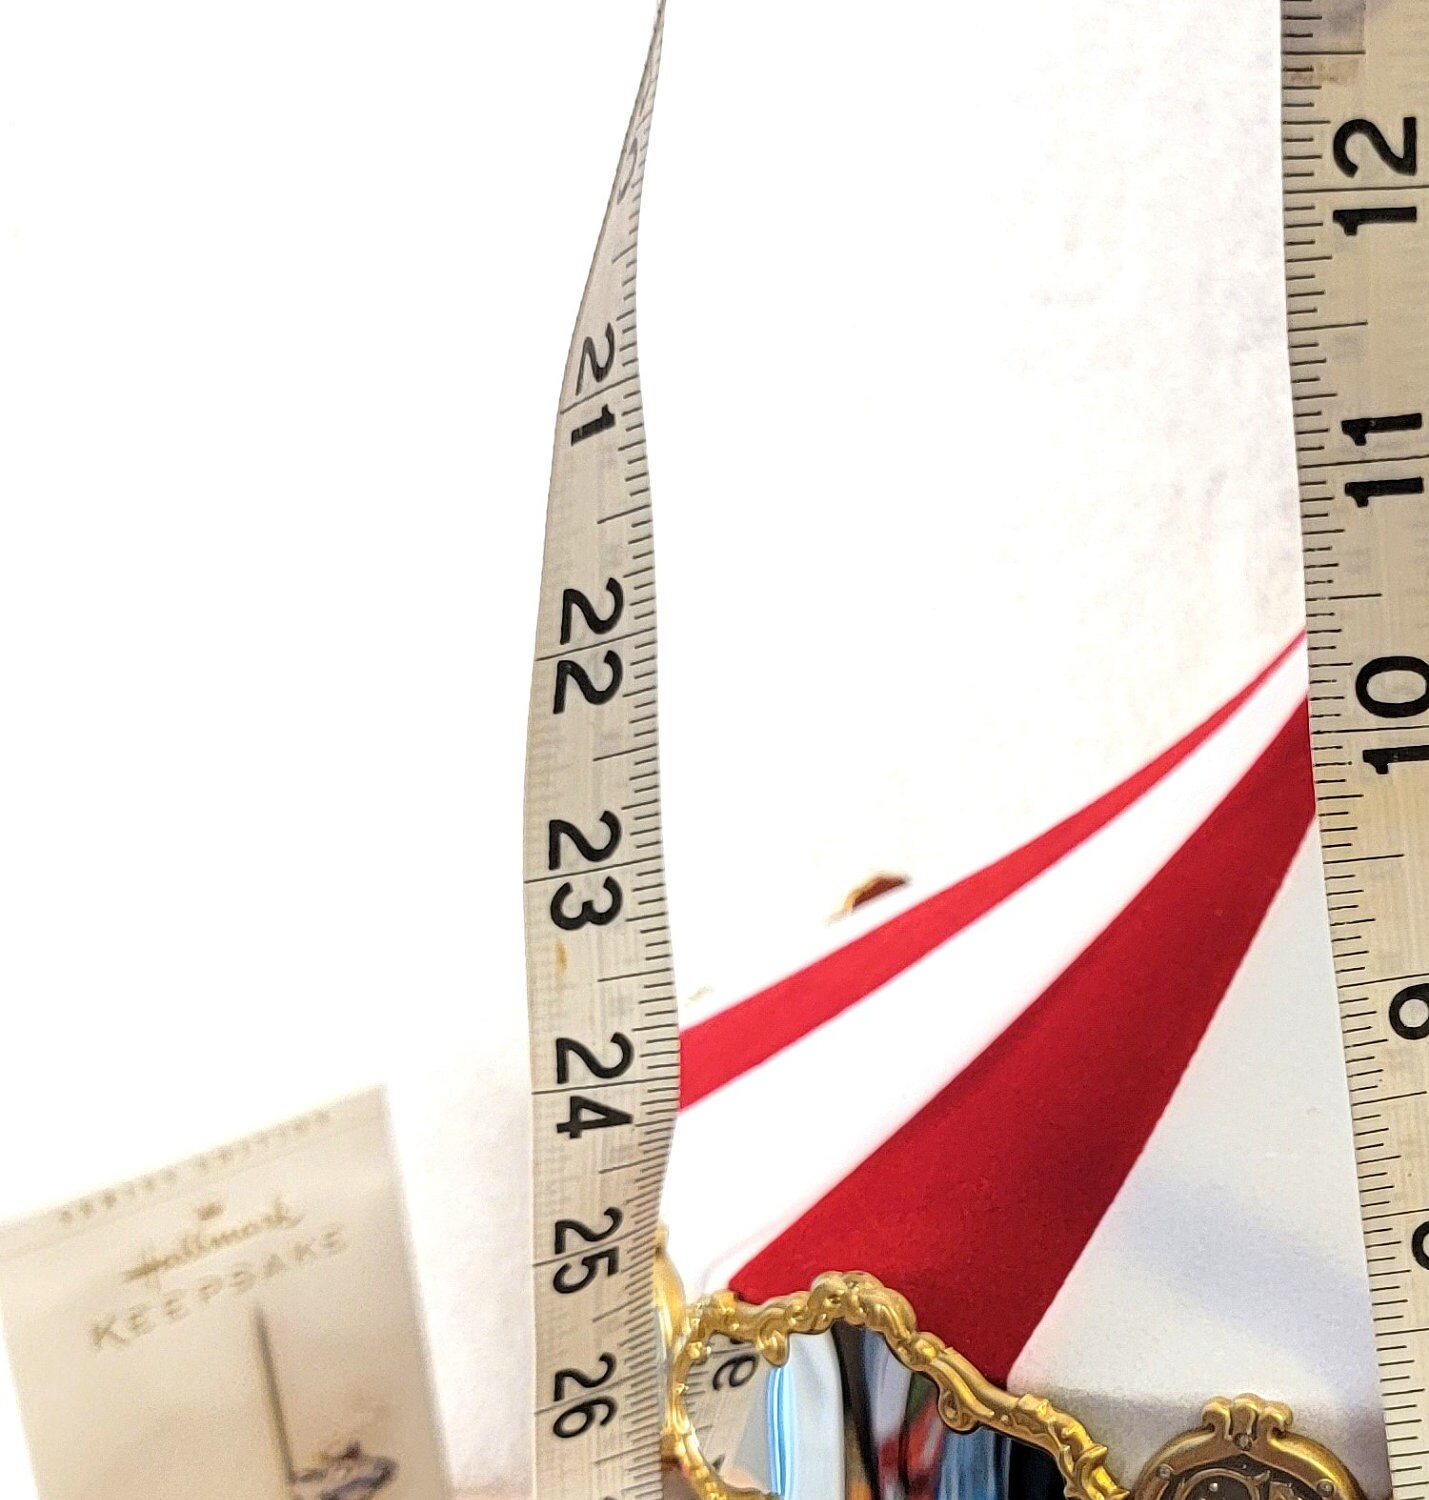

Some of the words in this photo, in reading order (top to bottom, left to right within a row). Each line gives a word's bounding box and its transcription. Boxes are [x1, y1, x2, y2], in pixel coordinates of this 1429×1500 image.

[1333, 116, 1417, 236] 12
[570, 322, 616, 446] 21
[1341, 412, 1424, 508] 11
[552, 577, 624, 715] 22
[548, 811, 623, 931] 23
[555, 1032, 634, 1139] 24
[89, 1224, 348, 1351] KEEPSAKE
[553, 1207, 624, 1294] 25
[553, 1352, 617, 1439] 26
